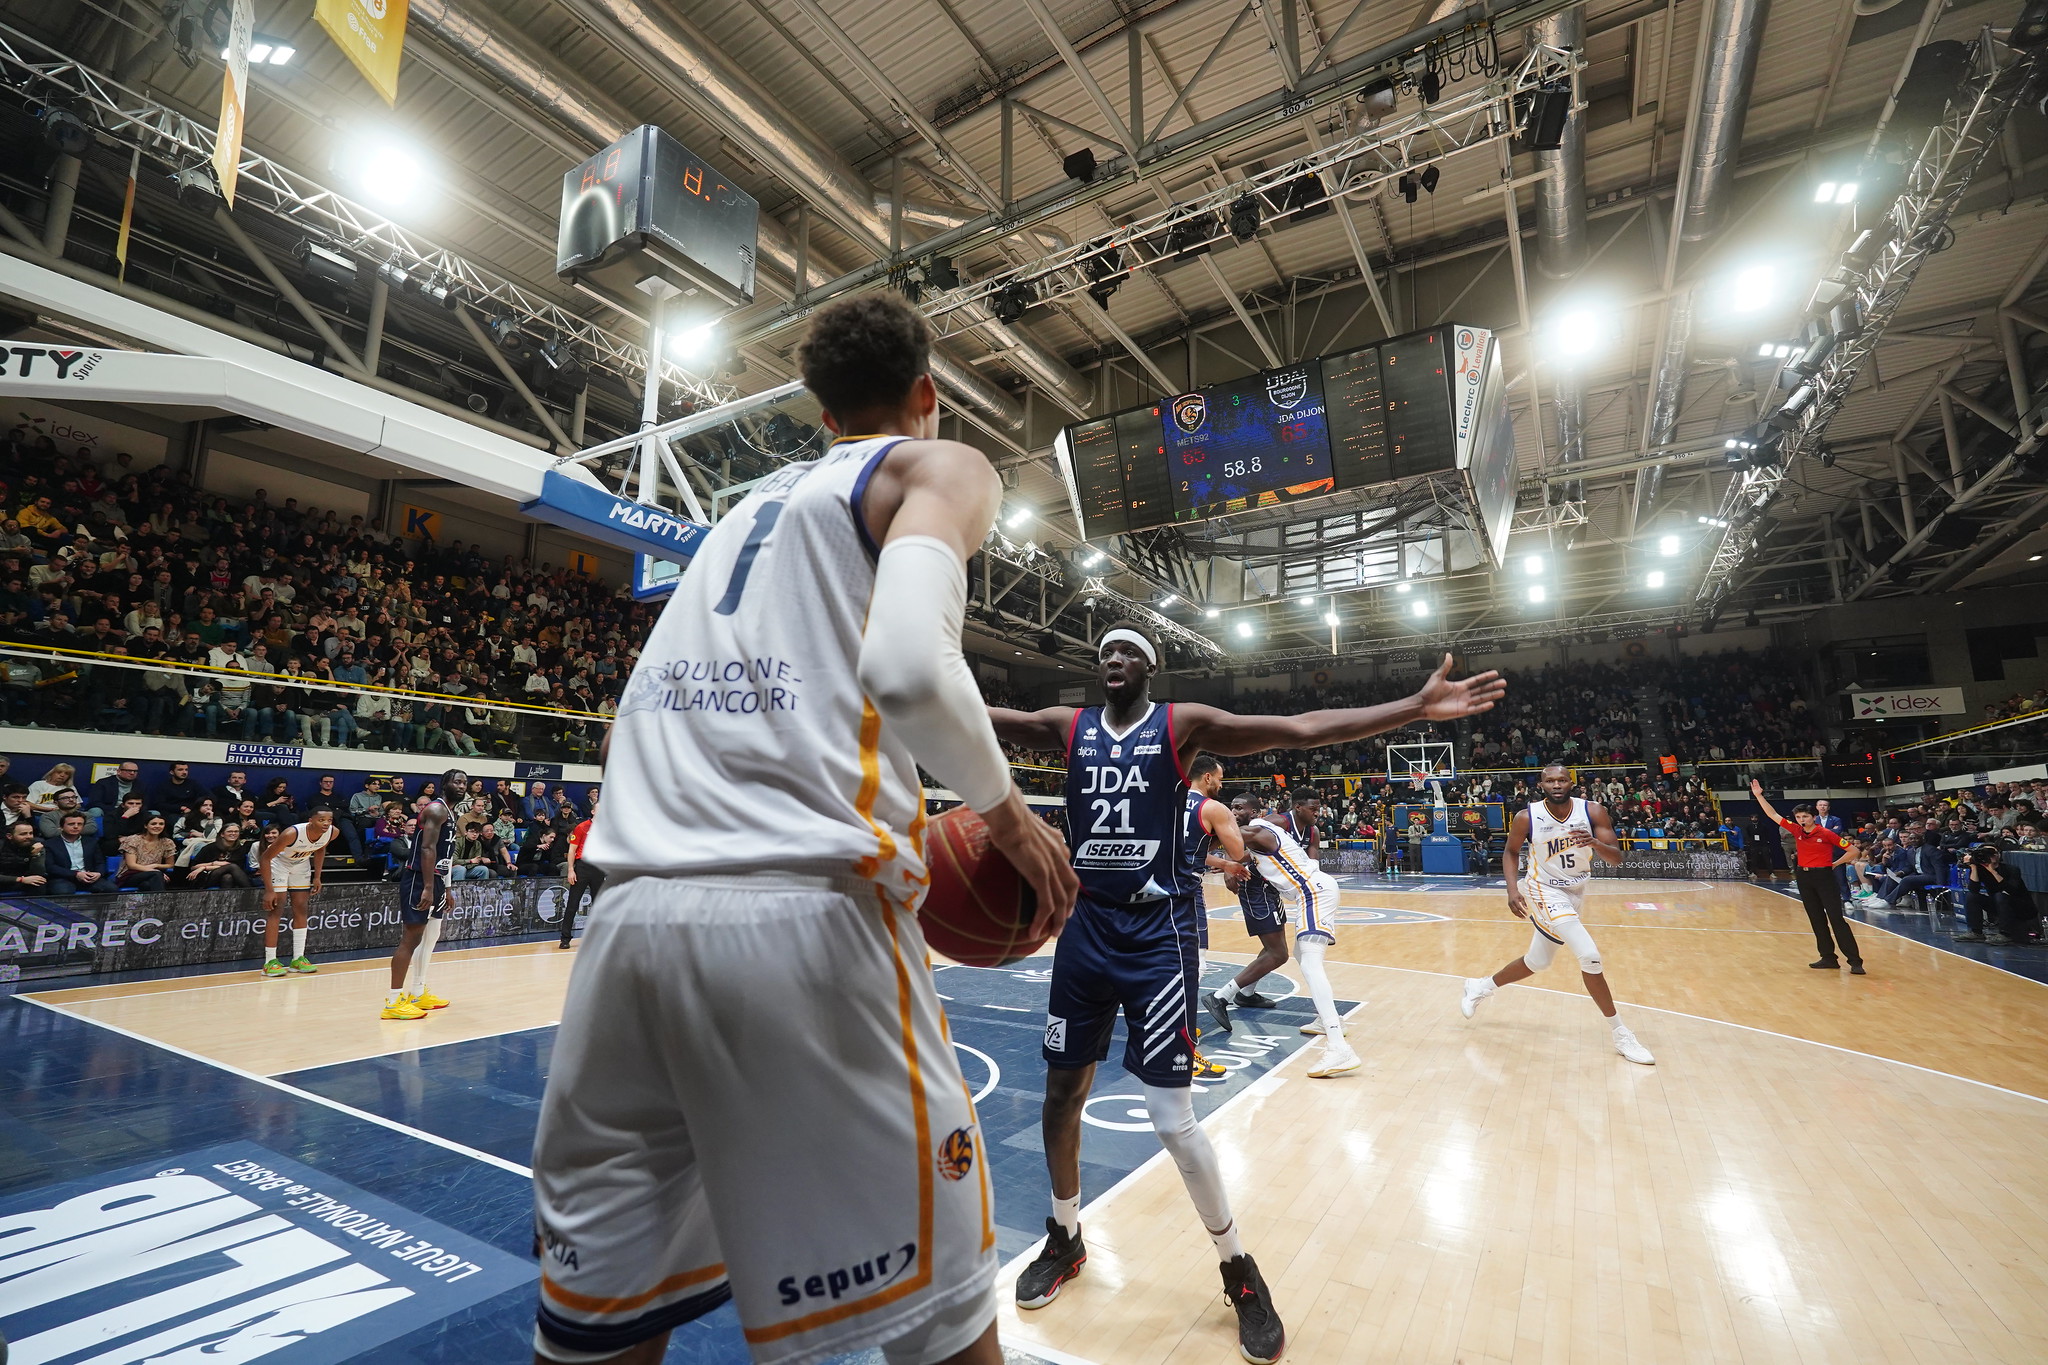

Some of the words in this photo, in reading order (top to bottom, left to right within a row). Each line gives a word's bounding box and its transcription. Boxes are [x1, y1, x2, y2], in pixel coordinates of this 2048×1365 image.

[1283, 104, 1300, 116] 300
[1472, 330, 1487, 369] Levallois
[72, 352, 103, 381] Sports
[1232, 395, 1240, 406] 3
[1278, 413, 1295, 424] JDA
[1297, 406, 1325, 419] DIJON
[1458, 386, 1476, 440] E.Leclerc
[50, 420, 99, 446] idex
[1176, 433, 1209, 447] METS92
[1281, 423, 1307, 442] 65
[1224, 456, 1262, 478] 58.8
[1306, 454, 1314, 465] 5
[1181, 481, 1189, 492] 2
[407, 508, 433, 539] K
[608, 501, 689, 542] MARTY
[680, 528, 698, 543] Sports
[577, 554, 592, 577] L
[714, 501, 784, 616] 1
[1890, 694, 1941, 710] idex
[229, 743, 302, 756] BOULOGNE
[228, 755, 300, 767] BILLANCOURT
[1081, 765, 1150, 794] JDA
[1348, 779, 1357, 791] Y
[1090, 799, 1136, 834] 21
[1085, 844, 1146, 857] ISERBA
[1321, 857, 1336, 866] plus
[1337, 856, 1374, 865] fraternelle
[1560, 854, 1575, 869] 15
[1593, 860, 1603, 869] et
[1625, 859, 1661, 869] société
[1664, 860, 1684, 871] plus
[1686, 860, 1740, 870] fraternelle
[181, 918, 211, 939] et
[218, 918, 266, 937] une
[212, 1158, 294, 1193] BASKET
[287, 1183, 305, 1206] de
[298, 1190, 413, 1249] NATIONALE
[390, 1235, 483, 1284] LIGUE
[777, 1252, 891, 1306] Sepur
